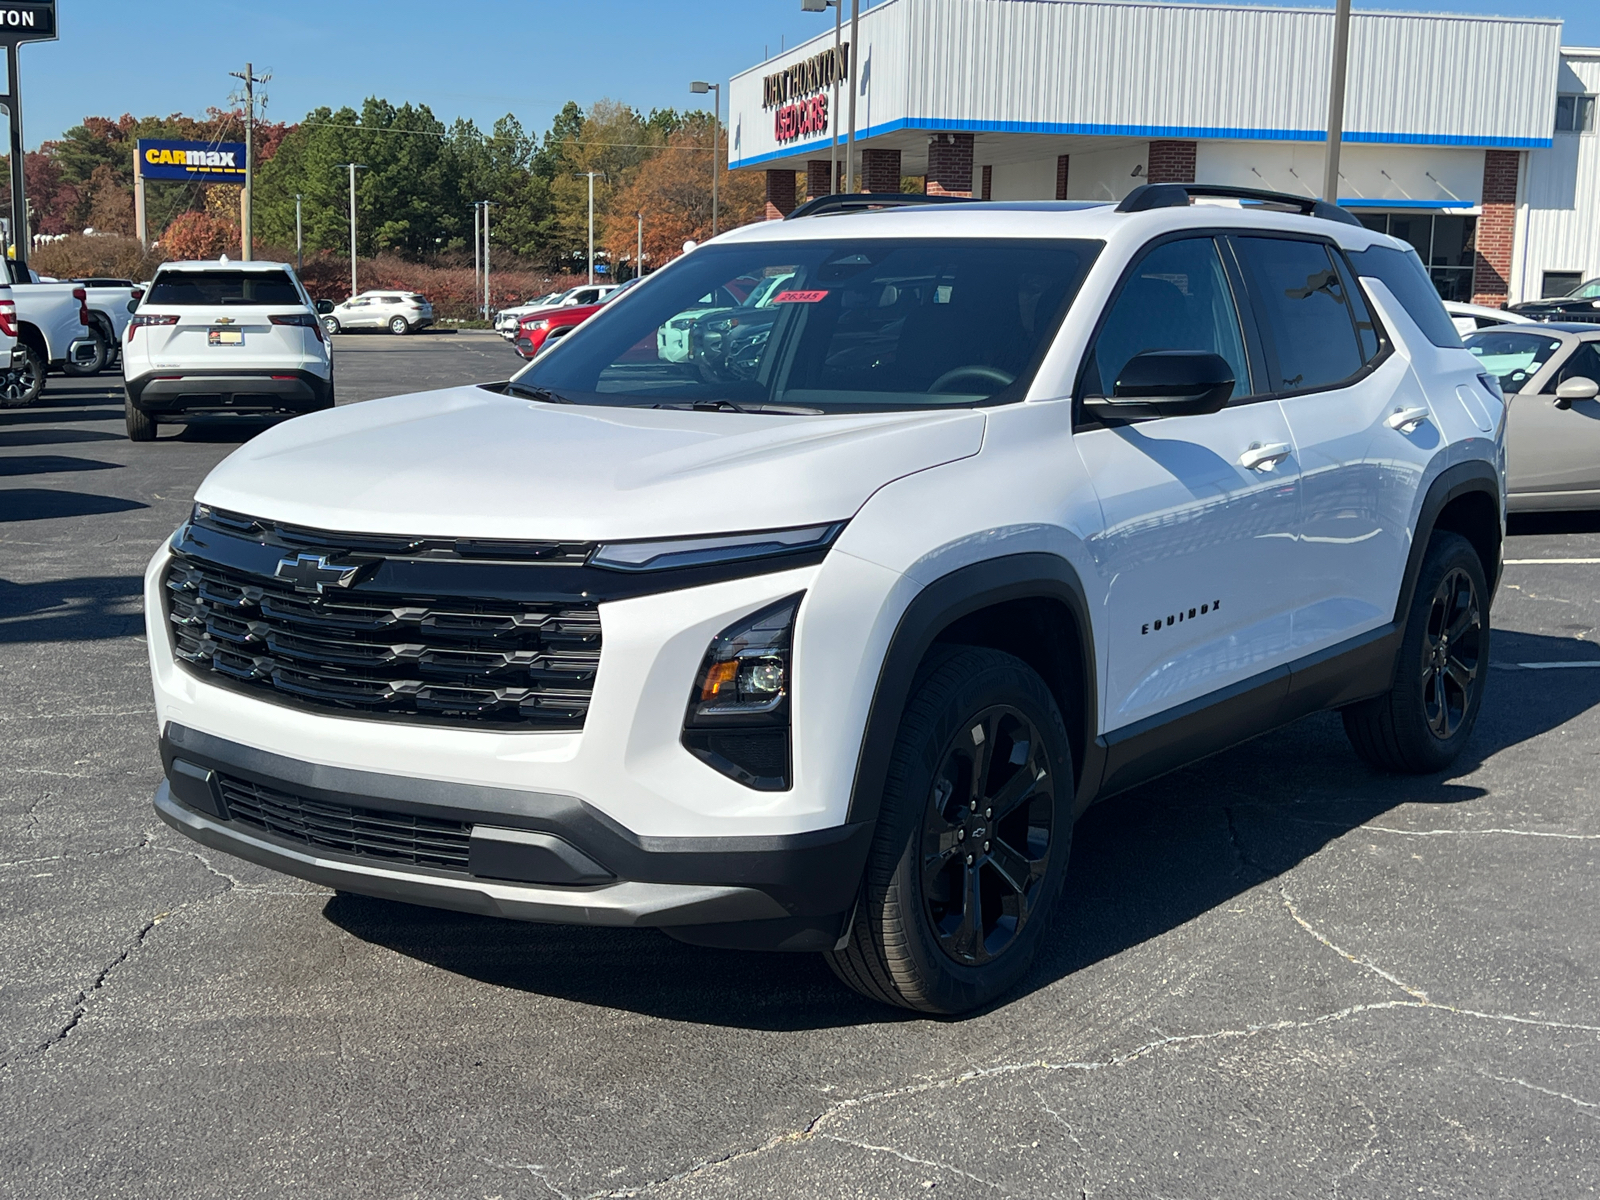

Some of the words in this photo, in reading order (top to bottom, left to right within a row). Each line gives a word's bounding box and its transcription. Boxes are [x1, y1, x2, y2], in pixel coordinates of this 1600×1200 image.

[0, 10, 34, 27] TON
[762, 70, 788, 109] JOHN
[787, 42, 849, 98] THORNTON
[775, 104, 797, 141] USED
[798, 94, 826, 134] CARS
[781, 292, 819, 300] 26345
[1141, 600, 1220, 635] EQUINOX
